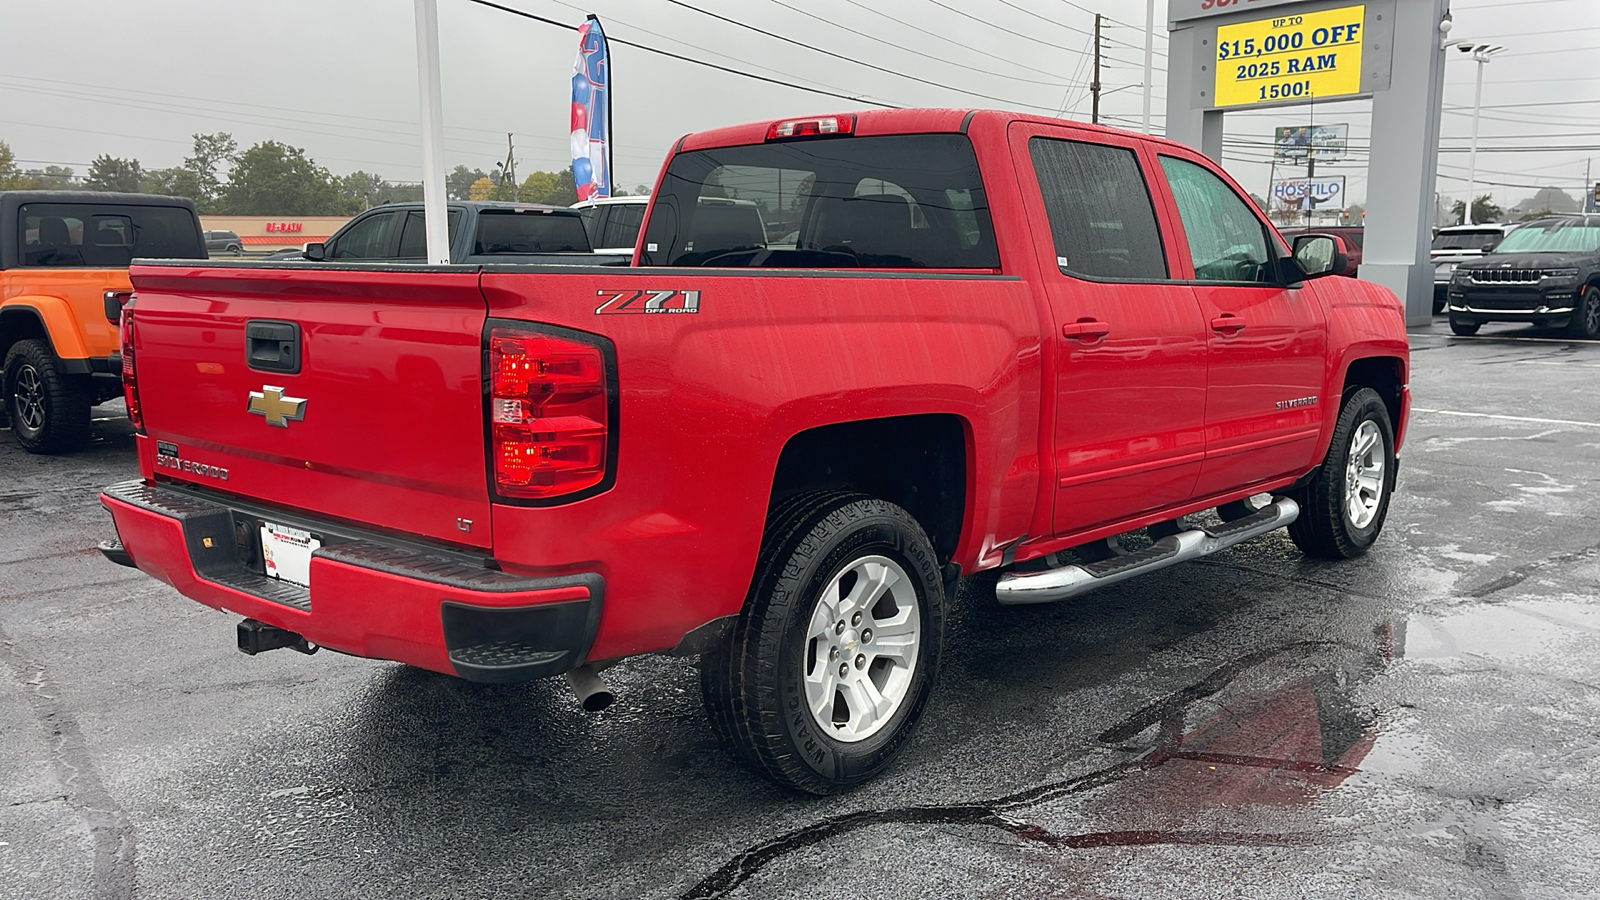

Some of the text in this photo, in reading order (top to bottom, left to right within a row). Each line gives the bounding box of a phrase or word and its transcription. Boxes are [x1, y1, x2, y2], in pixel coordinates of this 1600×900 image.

[1272, 16, 1303, 28] UP TO
[1219, 23, 1360, 60] $15,000 OFF
[1236, 53, 1337, 80] 2025 RAM
[1259, 80, 1311, 100] 1500!
[1275, 183, 1340, 197] HOSTILO
[594, 289, 701, 315] Z71
[1276, 396, 1318, 410] SILVERADO
[157, 453, 230, 481] SILVERADO
[457, 517, 473, 533] LT
